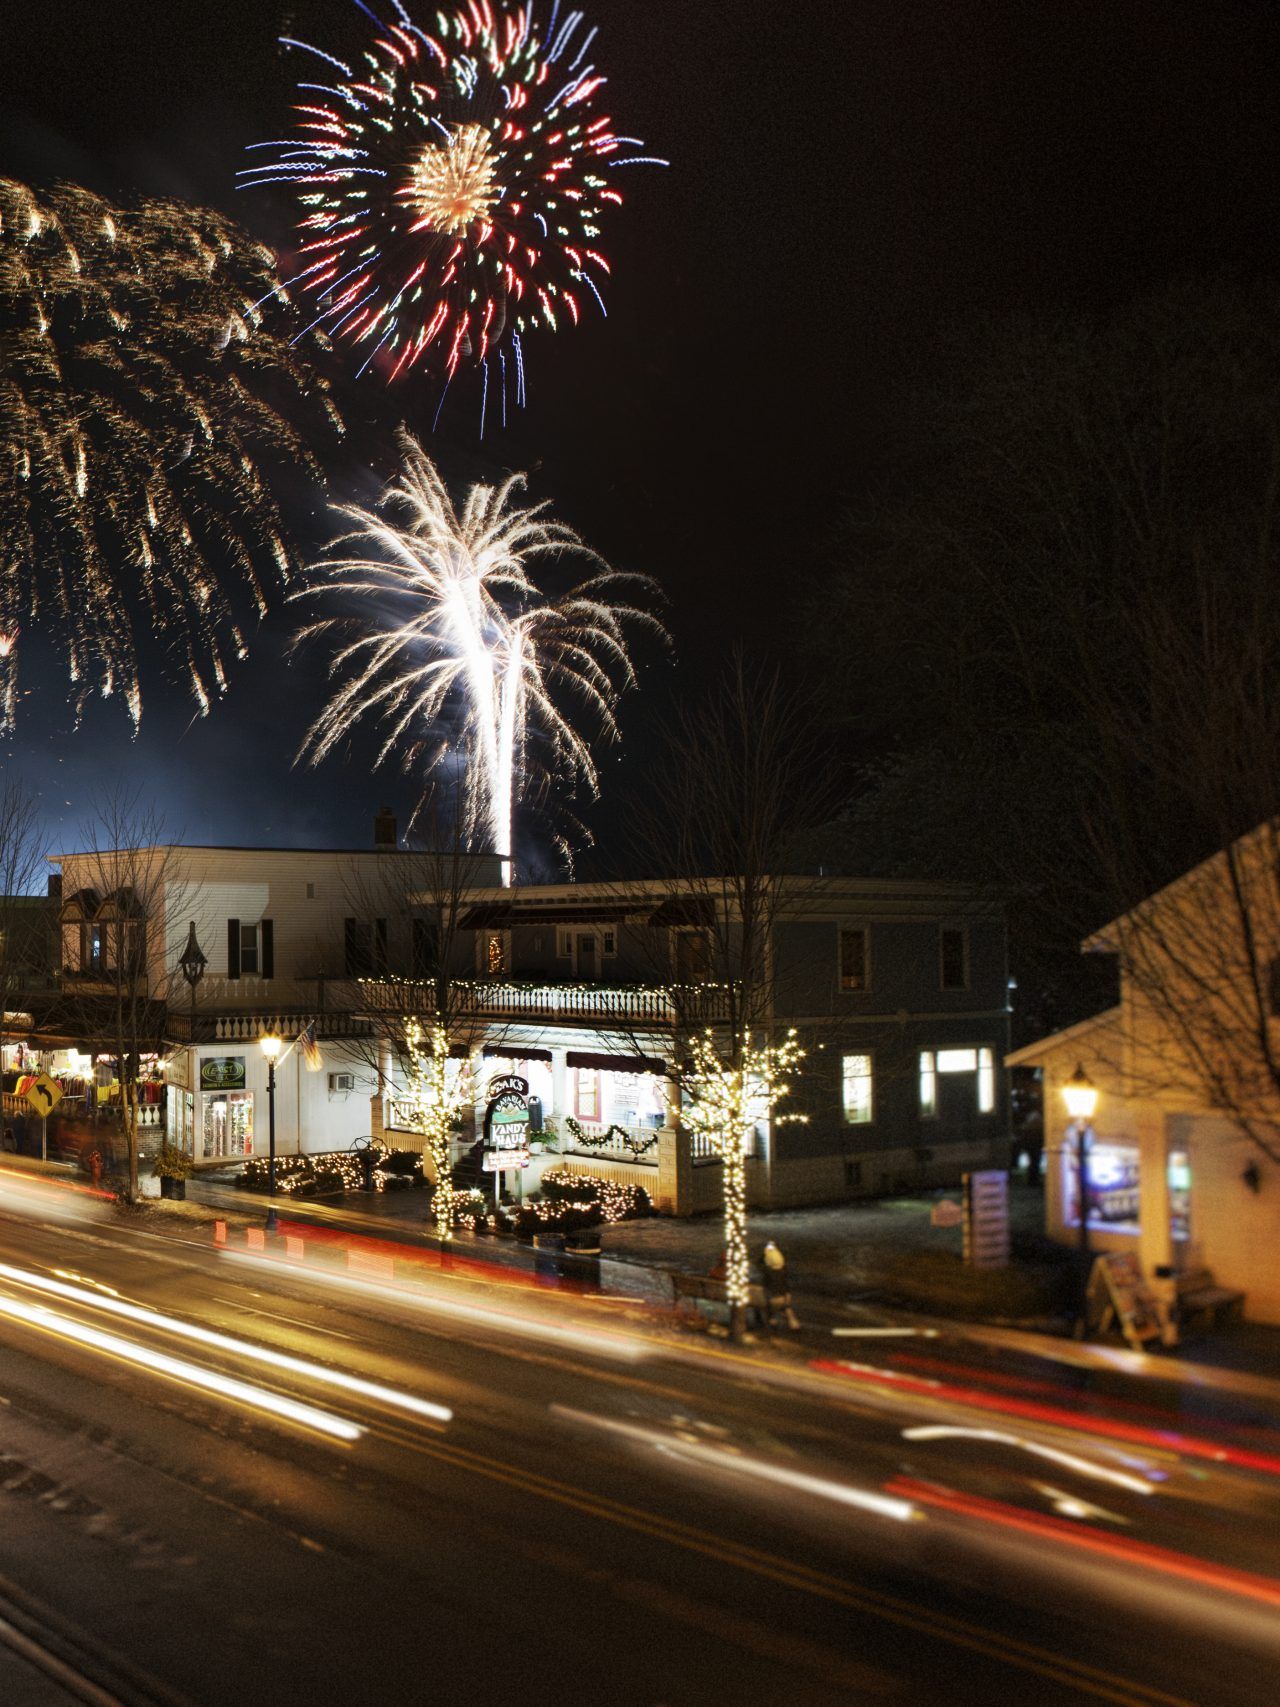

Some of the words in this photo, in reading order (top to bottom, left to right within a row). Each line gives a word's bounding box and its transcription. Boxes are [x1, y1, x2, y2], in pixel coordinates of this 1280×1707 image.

[495, 1095, 527, 1111] BAVARIAN
[492, 1123, 529, 1141] KANDY
[497, 1133, 526, 1147] HAUS
